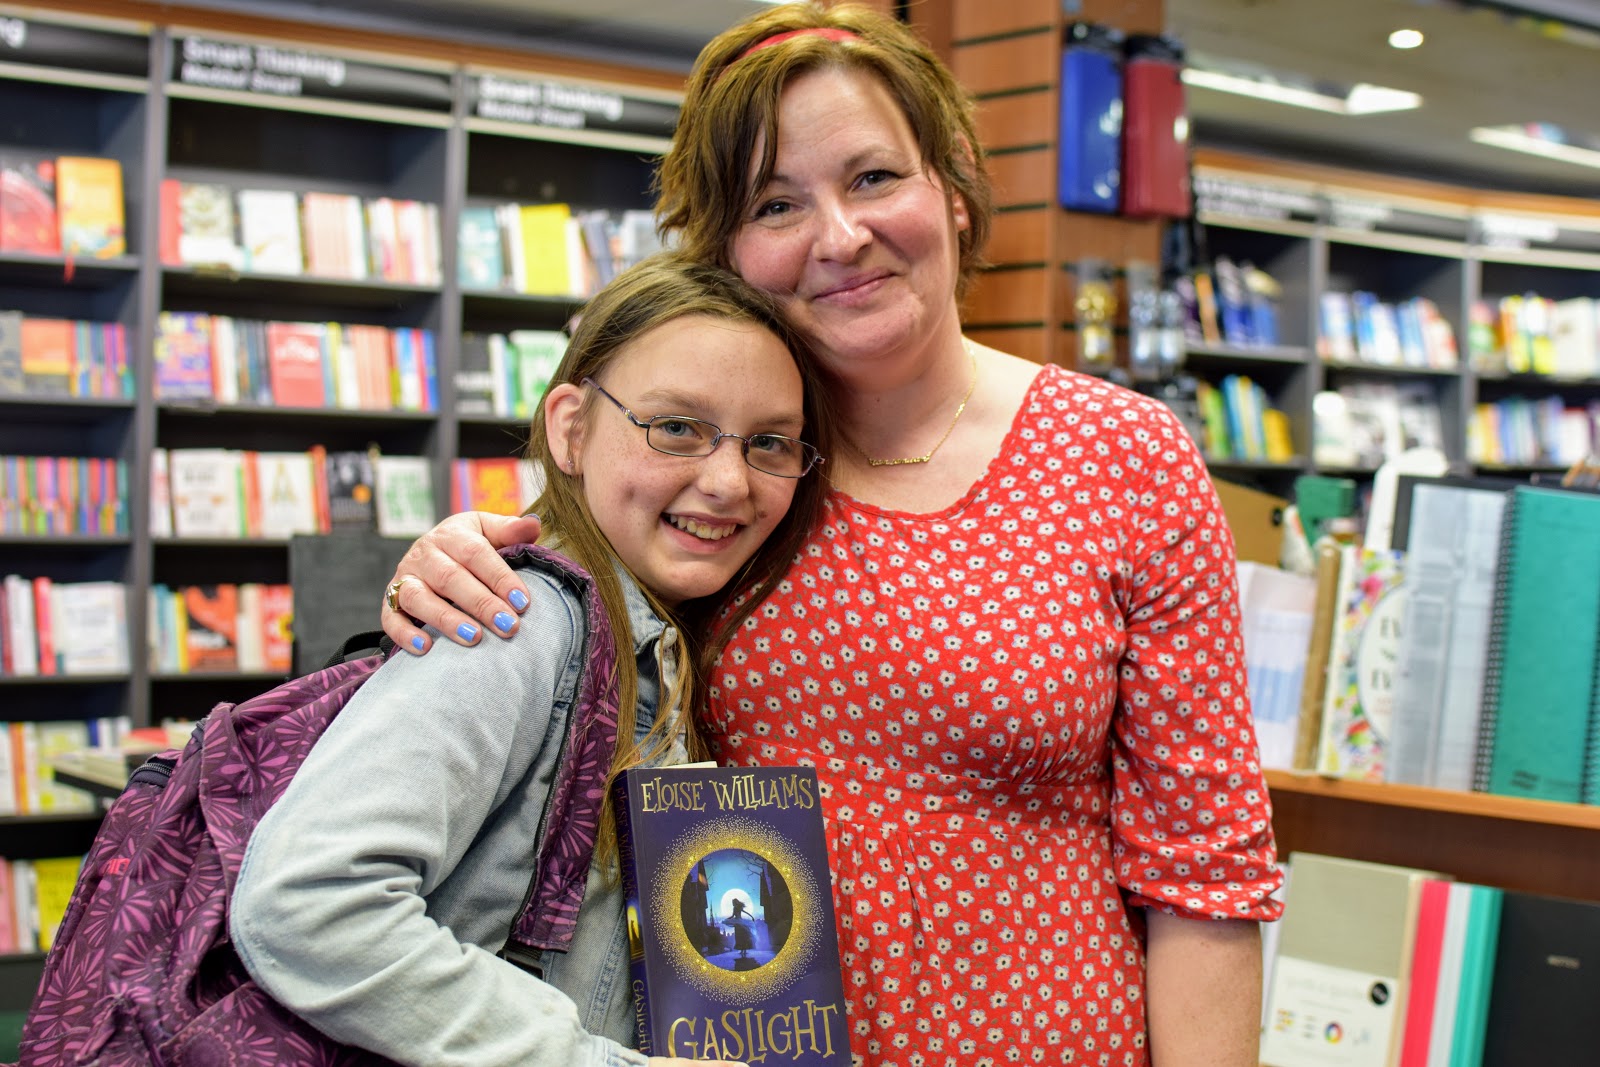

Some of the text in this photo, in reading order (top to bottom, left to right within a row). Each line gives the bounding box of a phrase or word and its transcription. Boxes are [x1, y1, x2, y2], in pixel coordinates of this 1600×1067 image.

[183, 37, 346, 87] Smart Thinking
[642, 774, 815, 813] ELOISE WILLIAMS
[632, 979, 652, 1053] GASLIGHT
[667, 1000, 838, 1063] GASLIGHT
